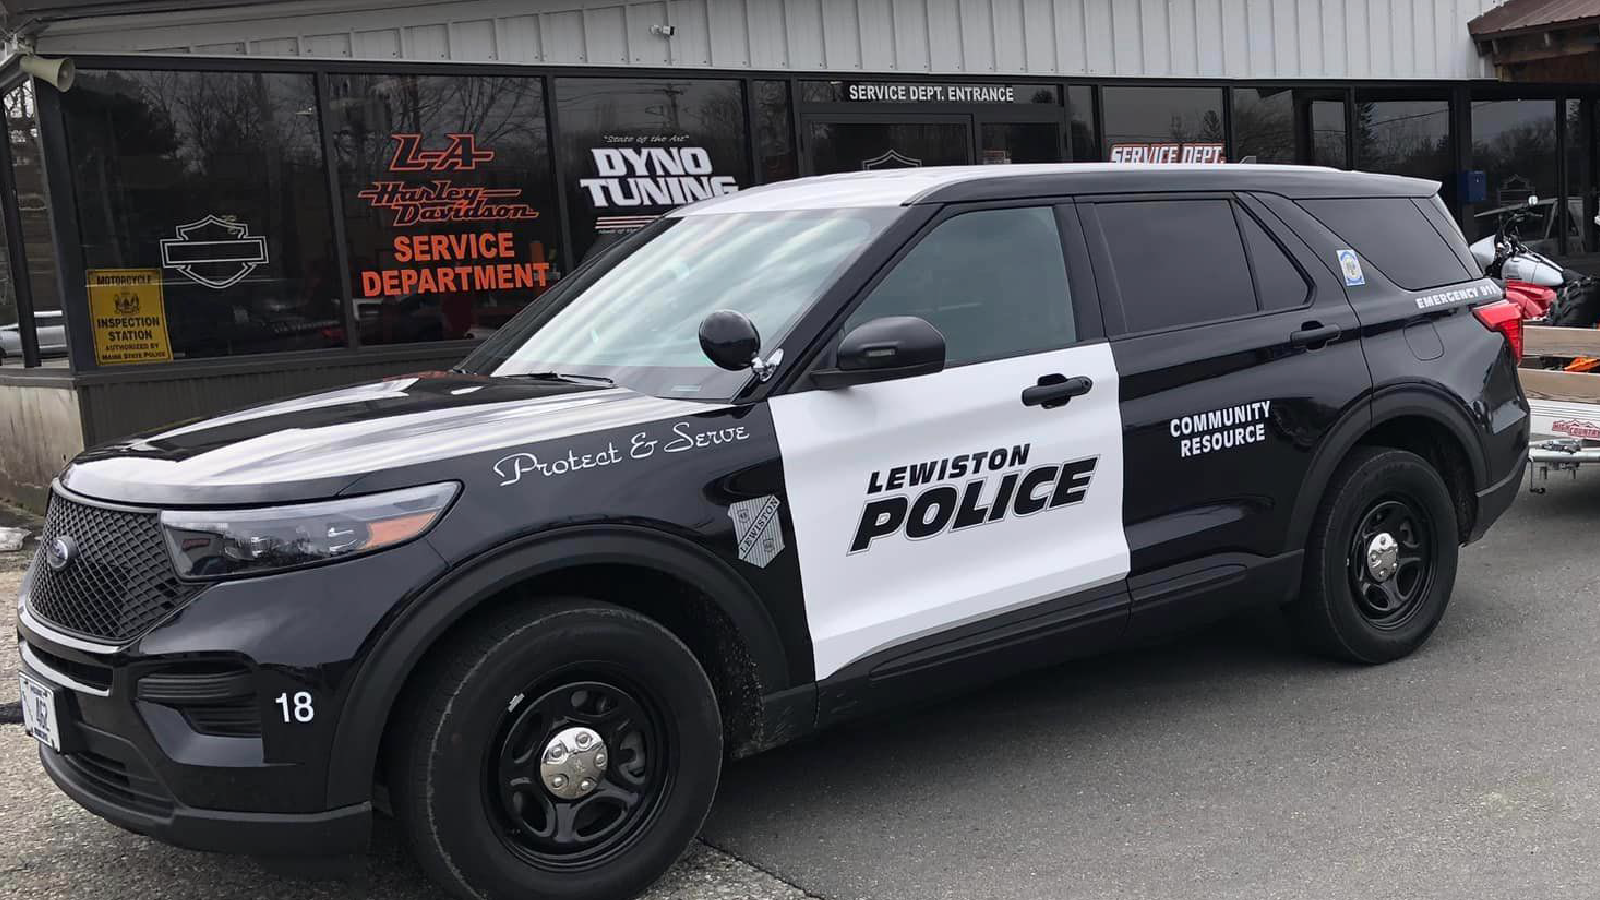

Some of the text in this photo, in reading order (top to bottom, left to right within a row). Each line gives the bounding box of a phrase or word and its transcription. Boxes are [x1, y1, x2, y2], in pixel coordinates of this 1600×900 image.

[849, 85, 1014, 102] SERVICE DEPT. ENTRANCE
[591, 147, 713, 177] DYNO
[1110, 145, 1227, 164] SERVICE DEPT.
[358, 180, 522, 208] Harley
[393, 201, 540, 226] Davidson
[393, 232, 515, 262] SERVICE
[96, 275, 151, 285] MOTORCYCLE
[362, 262, 550, 297] DEPARTMENT
[1416, 287, 1479, 309] EMERGENCY
[97, 316, 160, 329] INSPECTION
[107, 330, 152, 341] STATION
[1170, 401, 1271, 437] COMMUNITY
[493, 422, 750, 486] Protect & Serve
[1181, 424, 1266, 457] RESOURCE
[867, 443, 1031, 494] LEWISTON
[847, 454, 1101, 556] POLICE
[739, 497, 778, 553] LEWISTON
[275, 691, 314, 722] 18
